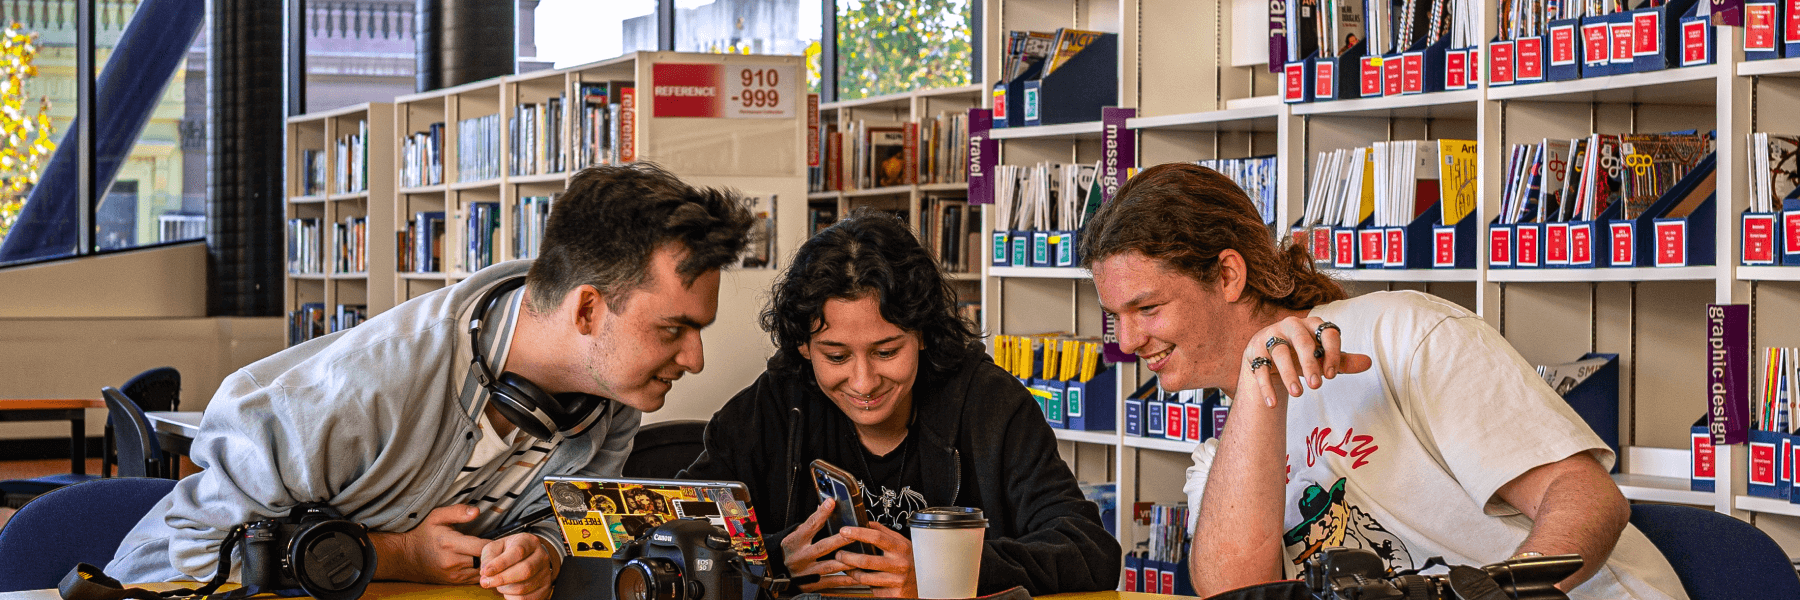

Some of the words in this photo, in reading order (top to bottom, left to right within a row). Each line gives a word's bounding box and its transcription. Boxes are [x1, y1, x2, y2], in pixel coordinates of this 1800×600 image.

[654, 86, 716, 97] REFERENCE
[741, 69, 779, 87] 910
[731, 89, 779, 108] -999
[622, 94, 635, 157] reference
[969, 135, 982, 178] travel
[1103, 124, 1118, 195] massage
[1709, 306, 1727, 379] graphic
[1711, 382, 1728, 445] design
[583, 517, 602, 526] FREE
[653, 533, 673, 542] Canon
